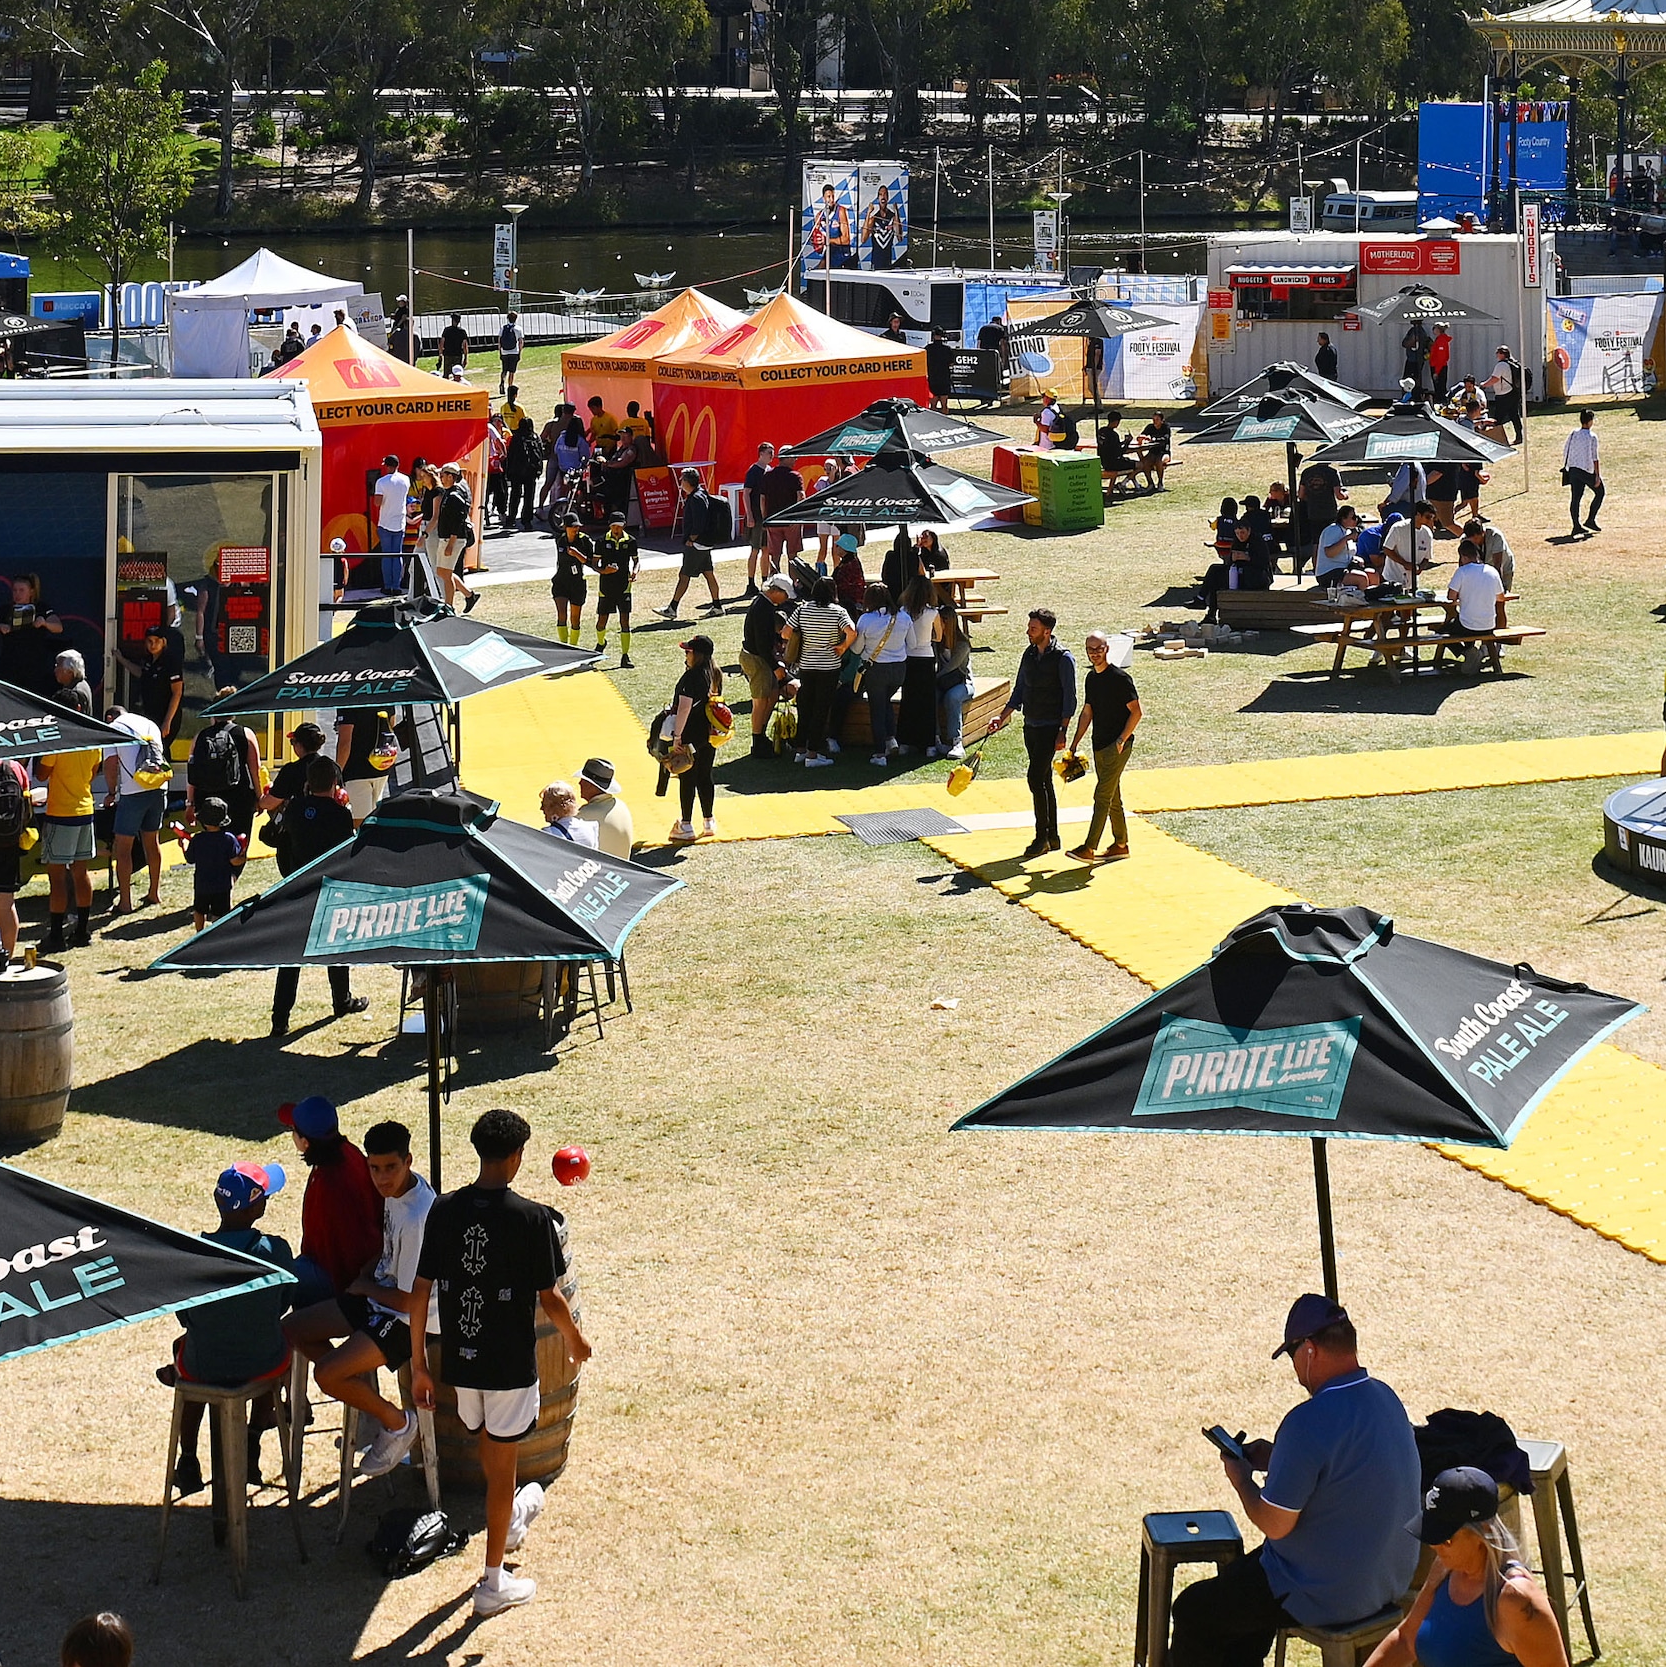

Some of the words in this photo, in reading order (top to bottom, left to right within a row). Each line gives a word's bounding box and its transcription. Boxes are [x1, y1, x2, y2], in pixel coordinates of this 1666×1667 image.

[1370, 250, 1416, 260] MOTHERLODE
[1403, 310, 1467, 318] PEPPERJACK
[1129, 343, 1150, 353] FOOTY
[1152, 342, 1181, 353] FESTIVAL
[1594, 336, 1614, 348] FOOTY
[1615, 336, 1643, 348] FESTIVAL
[567, 360, 592, 372] COLLECT
[593, 360, 611, 372] YOUR
[612, 361, 630, 372] CARD
[630, 361, 646, 372] HERE
[956, 355, 978, 365] GEH2
[657, 365, 684, 377] COLLECT
[760, 367, 810, 381] COLLECT
[813, 365, 840, 378] YOUR
[843, 362, 881, 376] CARD
[883, 359, 913, 373] HERE
[356, 402, 394, 416] YOUR
[396, 400, 434, 414] CARD
[437, 399, 471, 411] HERE
[920, 436, 956, 448] PALE
[957, 431, 980, 443] ALE
[643, 490, 663, 500] Filming
[645, 496, 669, 505] progress
[823, 497, 873, 506] South
[875, 496, 923, 506] Coast
[282, 669, 348, 686] South
[351, 664, 420, 682] Coast
[274, 683, 346, 701] PALE
[351, 678, 412, 696] ALE
[599, 870, 631, 904] ALE
[1434, 1008, 1486, 1062] South
[1474, 979, 1532, 1028] Coast
[1467, 1035, 1523, 1088] PALE
[1509, 998, 1570, 1058] ALE
